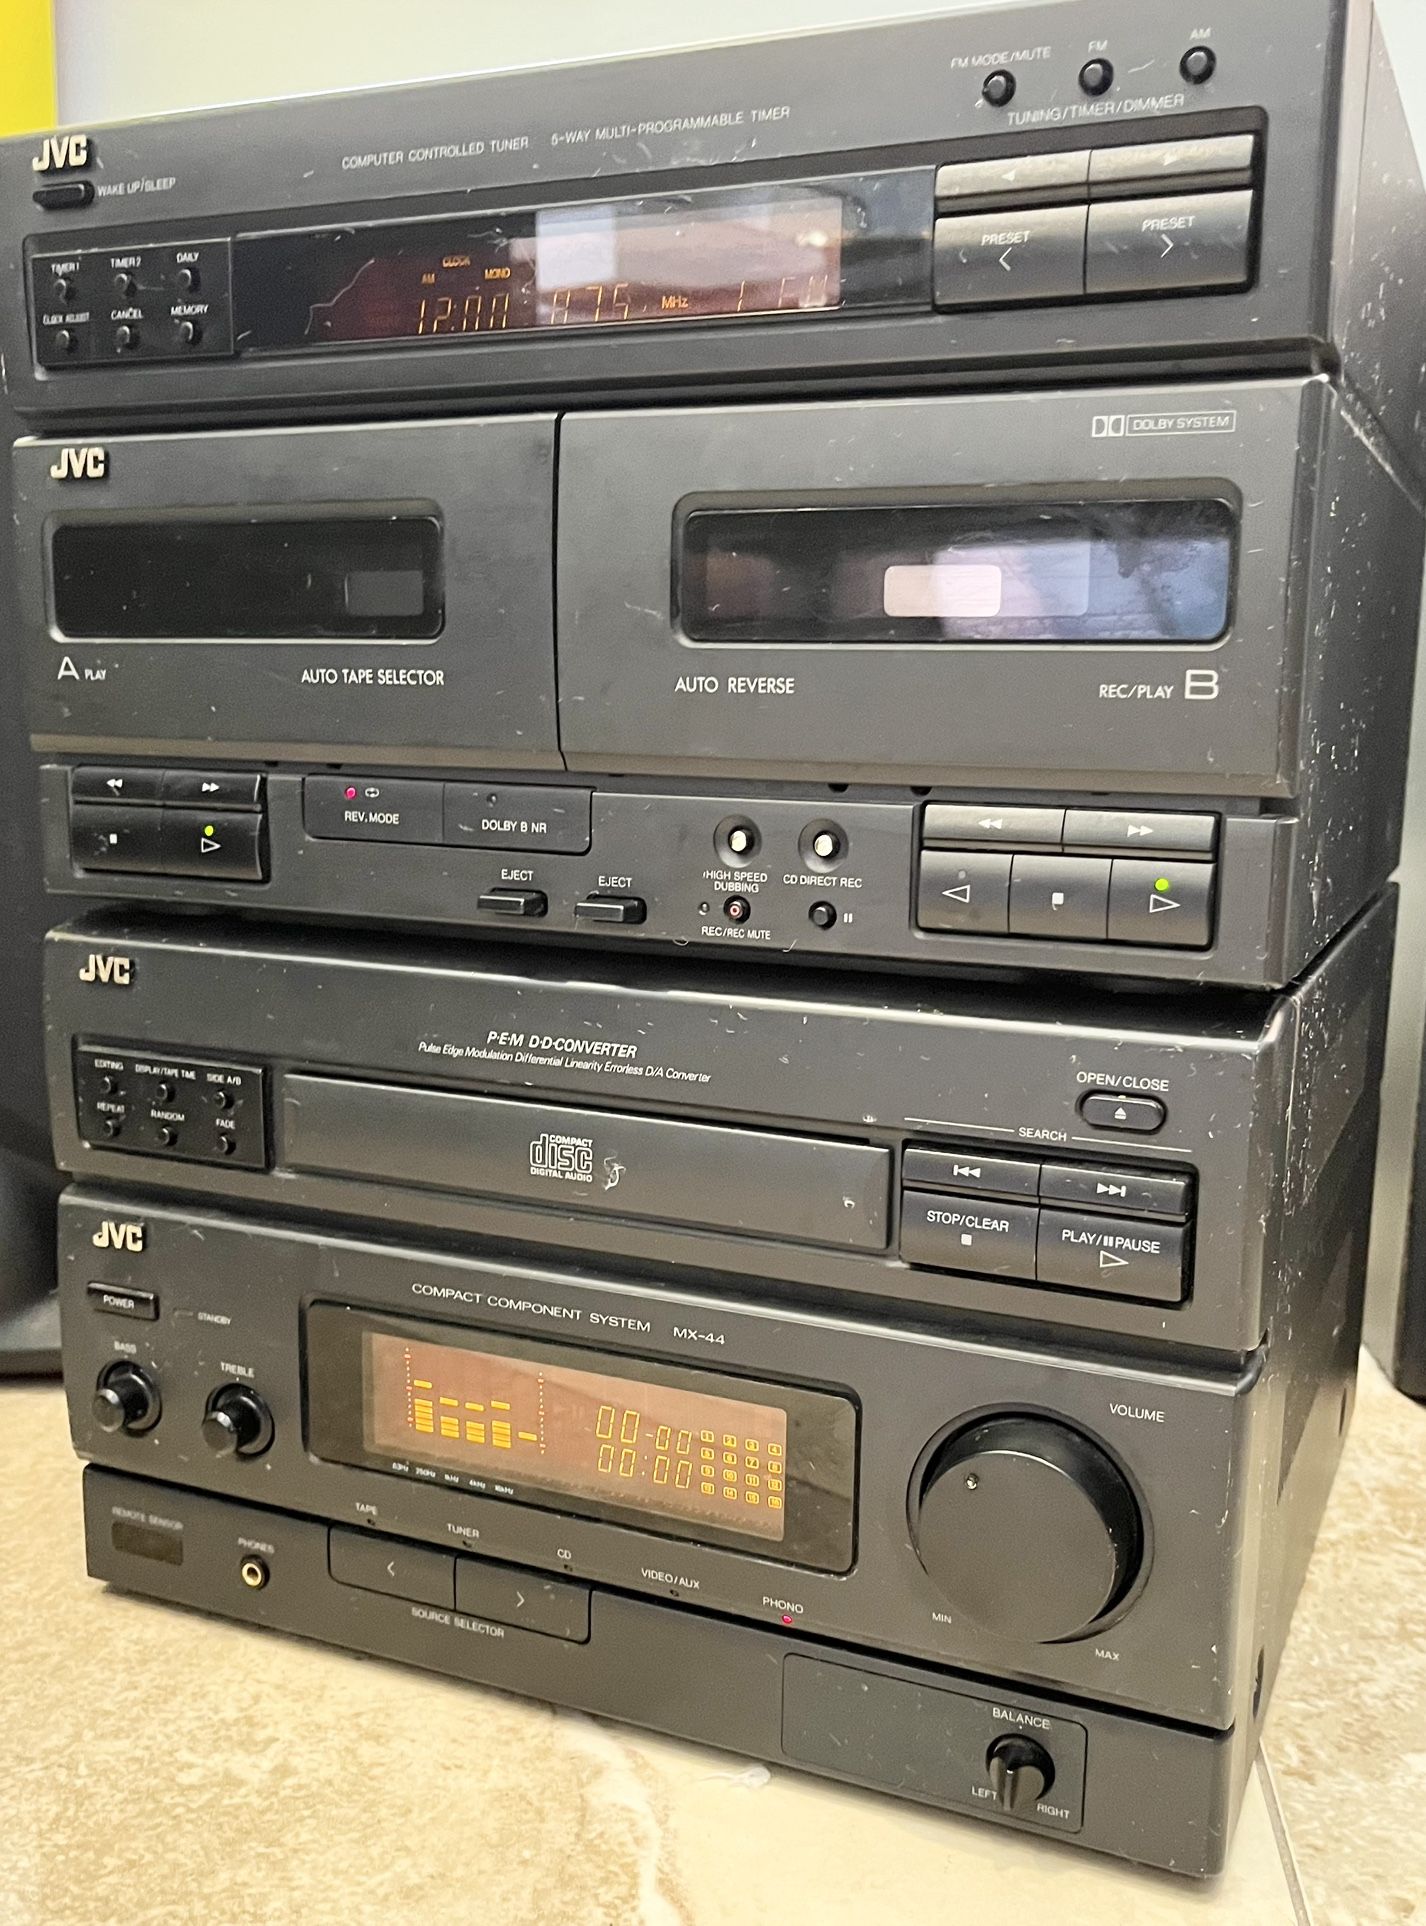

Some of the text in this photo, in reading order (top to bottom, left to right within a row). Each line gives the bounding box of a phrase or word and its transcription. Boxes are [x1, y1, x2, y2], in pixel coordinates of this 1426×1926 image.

[1189, 28, 1211, 39] AM
[1088, 40, 1108, 51] FM
[951, 47, 1052, 69] FM MODE/MUTE
[1007, 94, 1184, 126] TUNING/TIMER/DIMMER
[551, 106, 791, 146] 5-WAY MULTI-PROGRAMMABLE TIMER
[32, 134, 89, 172] JVC
[342, 136, 529, 169] COMPUTER CONTROLLED TUNER
[98, 177, 176, 197] WAKE UP/SLEEP
[1142, 217, 1196, 232] PRESET
[981, 231, 1031, 247] PRESET
[176, 252, 200, 264] DAILY
[421, 273, 436, 286] AM
[484, 267, 511, 280] MONO
[170, 304, 209, 316] MEMORY
[661, 295, 689, 310] MHz
[110, 308, 144, 321] CANCEL
[1133, 416, 1230, 431] DOLBY SYSTEM
[50, 447, 105, 479] JVC
[57, 656, 107, 681] A PLAY
[301, 668, 445, 687] AUTO TAPE SELECTOR
[674, 676, 795, 695] AUTO REVERSE
[1098, 669, 1220, 700] REC/PLAY B
[481, 819, 547, 834] DOLBY B NR
[501, 868, 534, 882] EJECT
[598, 875, 633, 889] EJECT
[704, 870, 768, 883] HIGH SPEED
[783, 874, 863, 888] CD DIRECT REC
[714, 881, 759, 893] DUBBING
[701, 926, 771, 940] REC/REC MUTE
[79, 953, 131, 985] JVC
[95, 1058, 124, 1071] EDITING
[418, 1041, 711, 1083] Pulse Edge Modulation Differential Linearity Errorless D/A Converter
[135, 1064, 197, 1080] DISPLAY/TAPE TIME
[206, 1073, 242, 1086] SIDE A/B
[1076, 1071, 1170, 1092] OPEN/CLOSE
[97, 1102, 126, 1114] REPEAT
[150, 1109, 186, 1122] RANDOM
[215, 1118, 236, 1130] FADE
[549, 1134, 593, 1148] COMPACT
[1018, 1127, 1067, 1142] SEARCH
[530, 1133, 593, 1174] disc
[530, 1166, 593, 1182] DIGITAL AUDIO
[926, 1210, 1010, 1233] STOP/CLEAR
[92, 1221, 144, 1252] JVC
[103, 1294, 135, 1310] POWER
[197, 1312, 233, 1326] STANDBY
[411, 1283, 726, 1345] COMPACT COMPONENT SYSTEM MX-44
[114, 1340, 137, 1355] BASS
[219, 1361, 255, 1379] TREBLE
[1108, 1402, 1166, 1424] VOLUME
[355, 1502, 379, 1516] TAPE
[447, 1523, 480, 1539] TUNER
[556, 1548, 572, 1560] CD
[641, 1567, 700, 1590] VIDEO/AUX
[762, 1595, 804, 1615] PHONO
[411, 1606, 505, 1639] SOURCE SELECTOR
[932, 1611, 952, 1624] MIN
[1095, 1648, 1120, 1662] MAX
[992, 1706, 1052, 1730] BALANCE
[971, 1785, 998, 1801] LEFT
[1036, 1802, 1070, 1820] RIGHT
